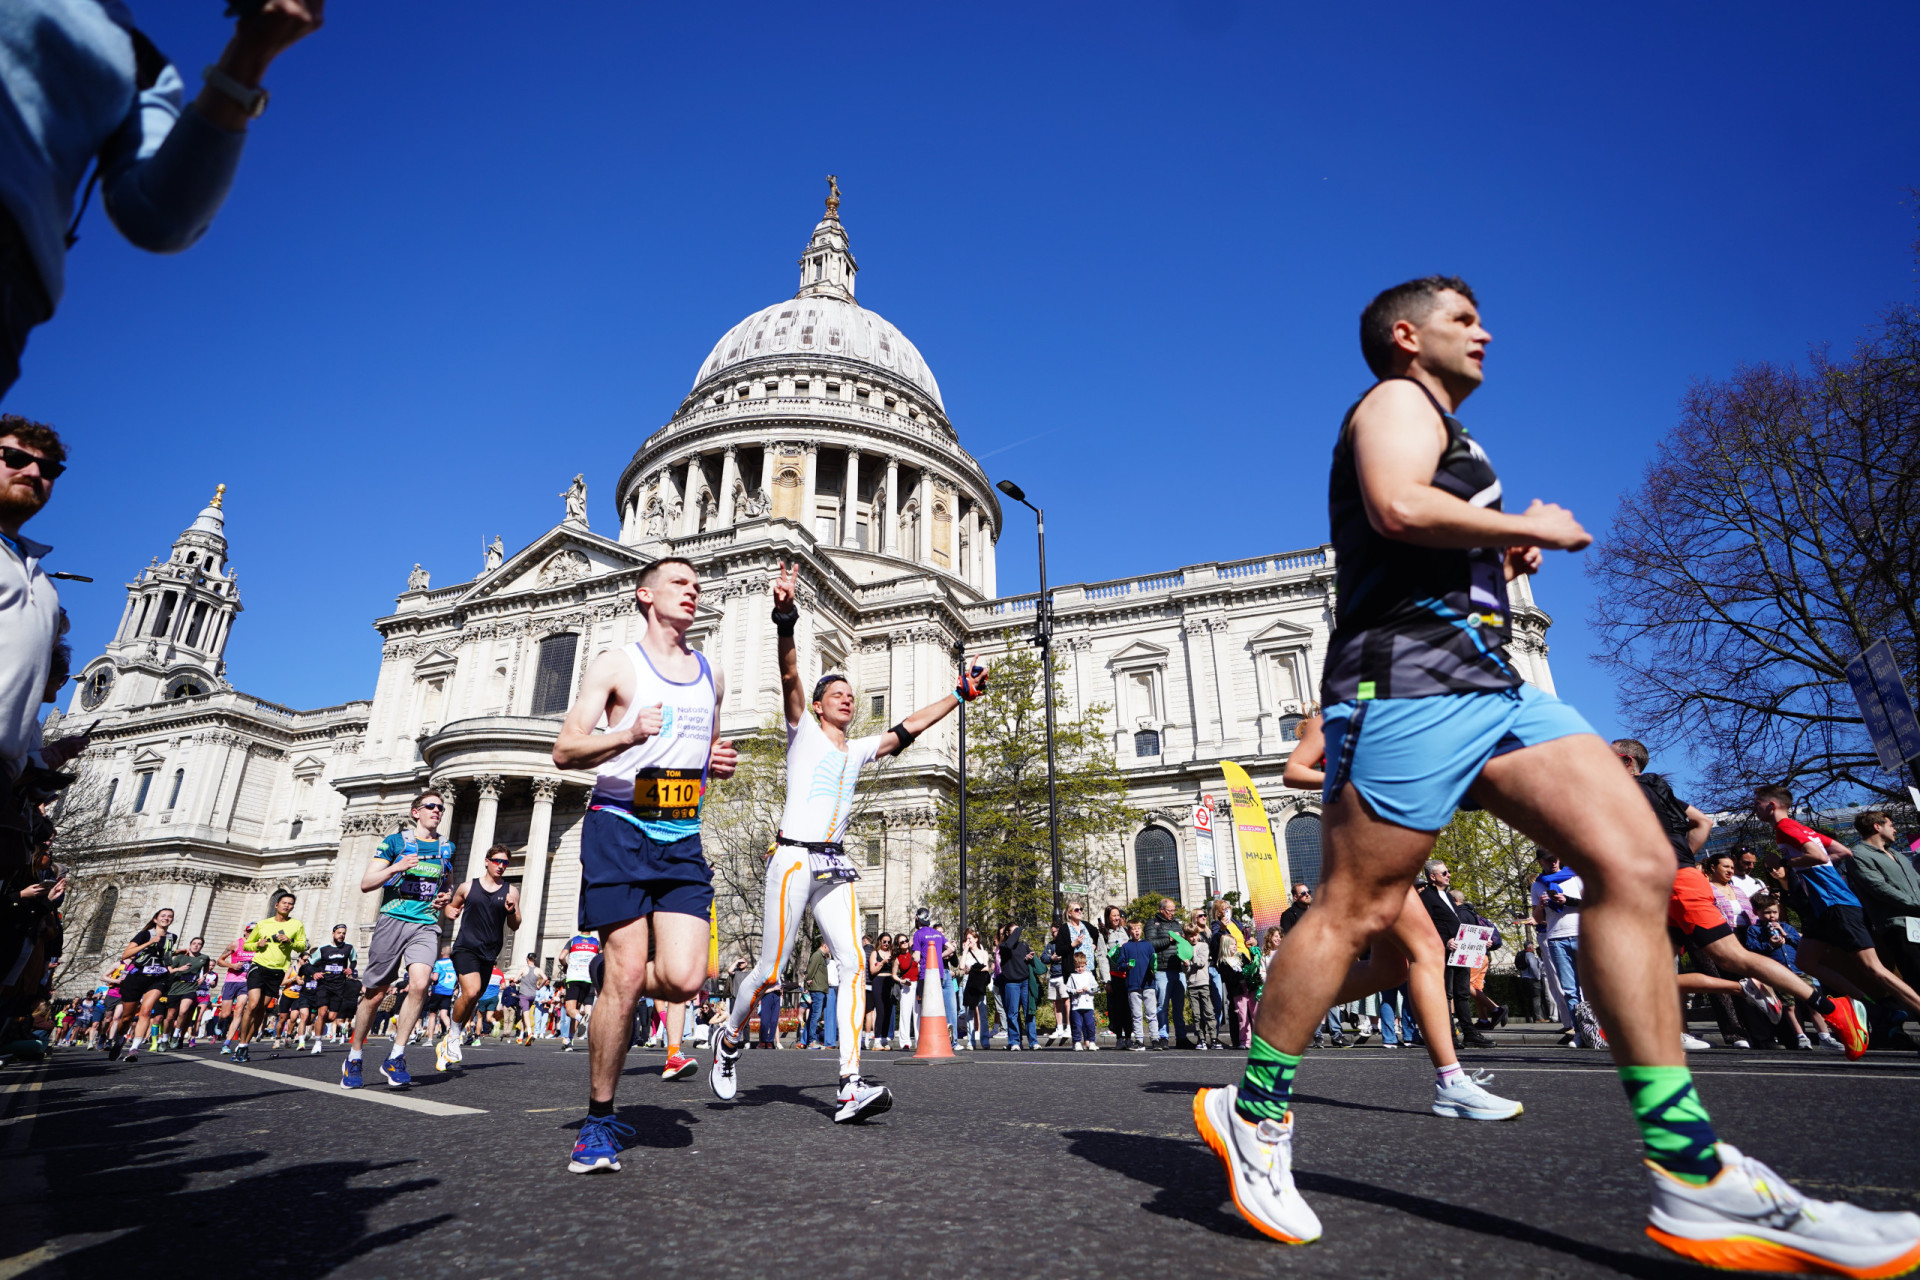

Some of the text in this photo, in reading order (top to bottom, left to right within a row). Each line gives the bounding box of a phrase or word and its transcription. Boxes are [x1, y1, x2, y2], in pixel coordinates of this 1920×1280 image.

[1852, 651, 1884, 679] No acess
[1876, 662, 1894, 680] Bank
[677, 715, 705, 724] Allergy
[1895, 721, 1915, 739] buses
[646, 784, 693, 802] 4110
[408, 882, 432, 893] 1334
